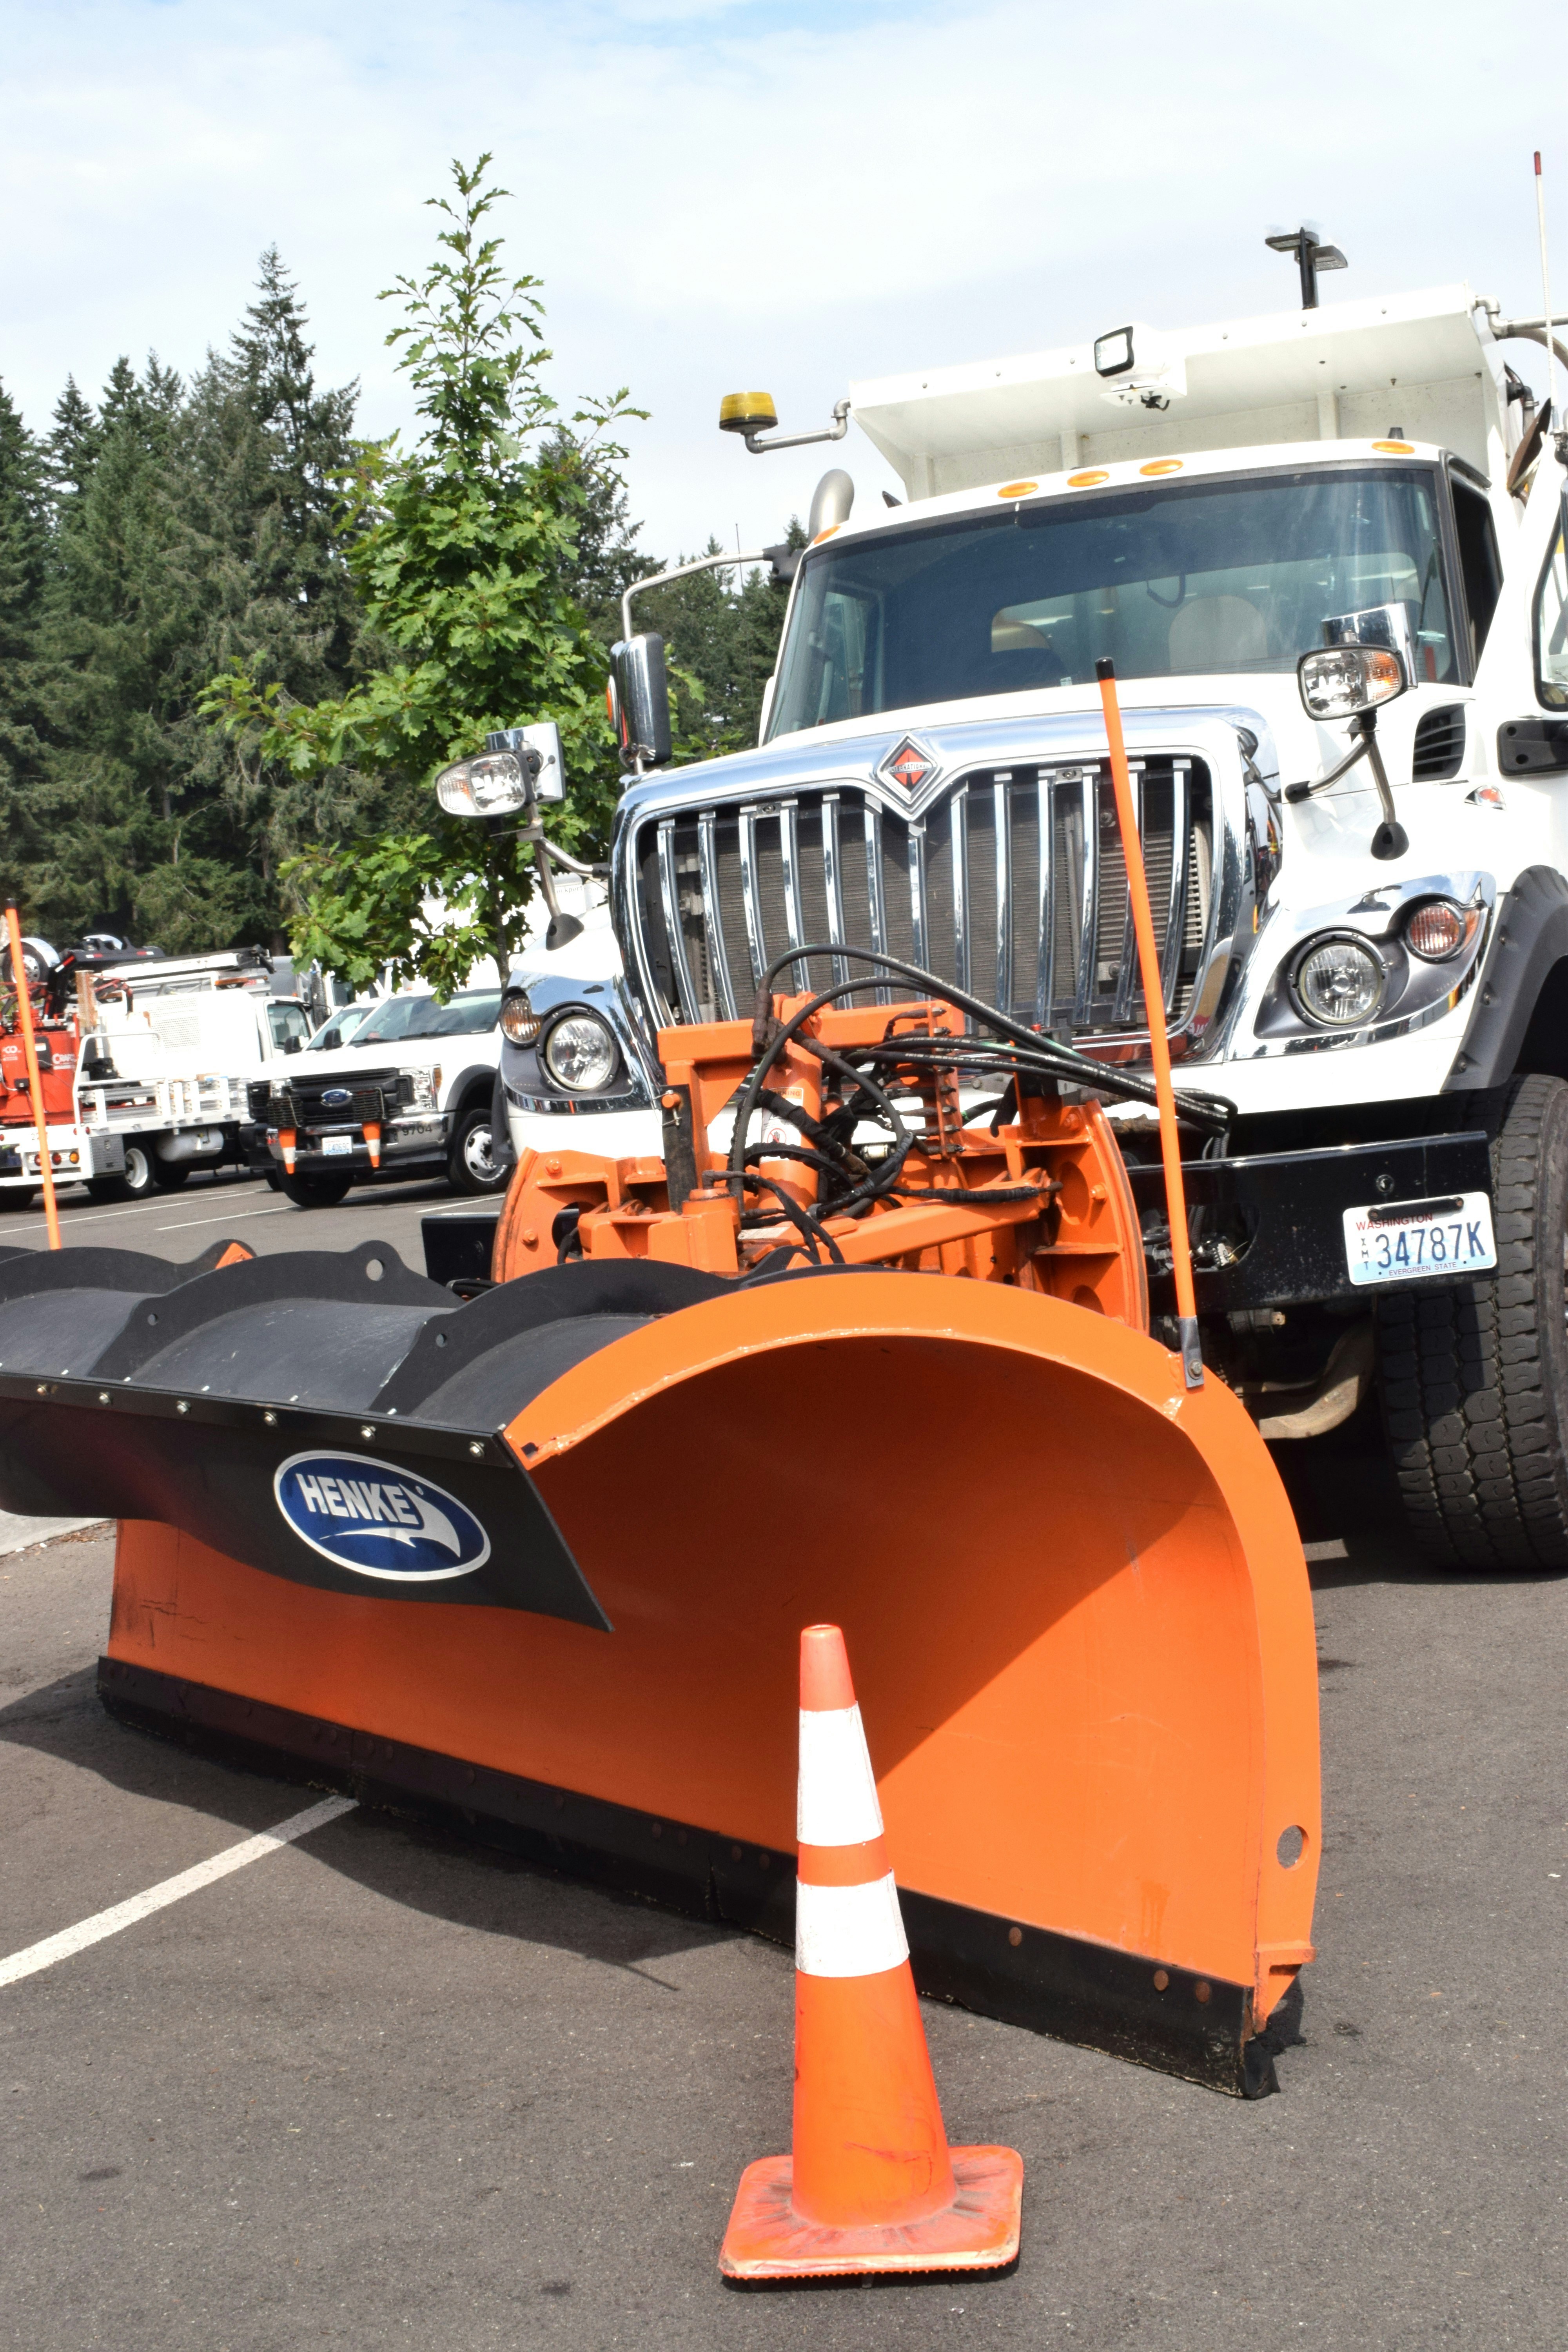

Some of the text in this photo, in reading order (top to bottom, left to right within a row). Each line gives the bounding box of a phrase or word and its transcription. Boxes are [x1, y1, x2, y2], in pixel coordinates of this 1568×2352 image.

[1356, 1212, 1433, 1230] WASHINGTON
[1375, 1220, 1486, 1269] 34787K
[1388, 1261, 1457, 1276] EVERGREEN STATE
[296, 1473, 419, 1524] HENKE
